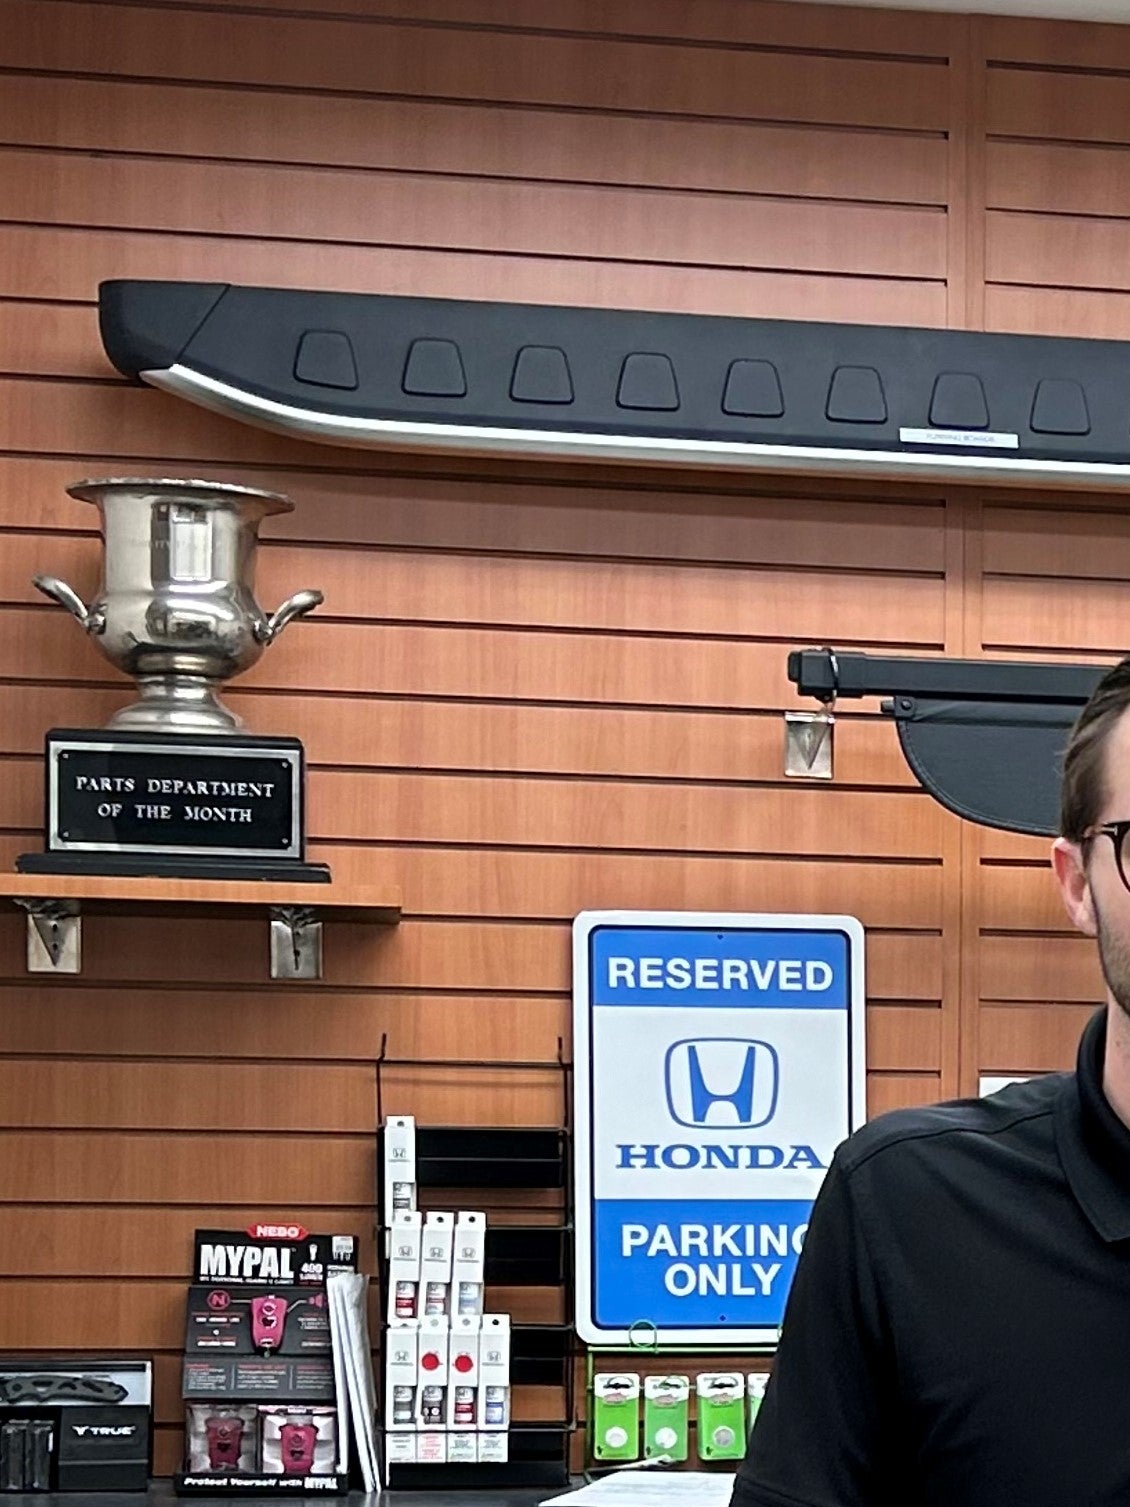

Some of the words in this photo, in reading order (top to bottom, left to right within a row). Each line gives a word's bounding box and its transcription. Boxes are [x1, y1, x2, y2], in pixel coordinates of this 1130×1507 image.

[75, 775, 136, 793] PARTS
[147, 779, 275, 798] DEPARTMENT
[98, 803, 123, 818] OF
[135, 804, 172, 820] THE
[183, 806, 253, 823] MONTH
[607, 956, 834, 991] RESERVED
[615, 1143, 829, 1170] HONDA
[256, 1225, 300, 1238] NEBO
[200, 1244, 295, 1279] MYPAL
[663, 1262, 783, 1297] ONLY
